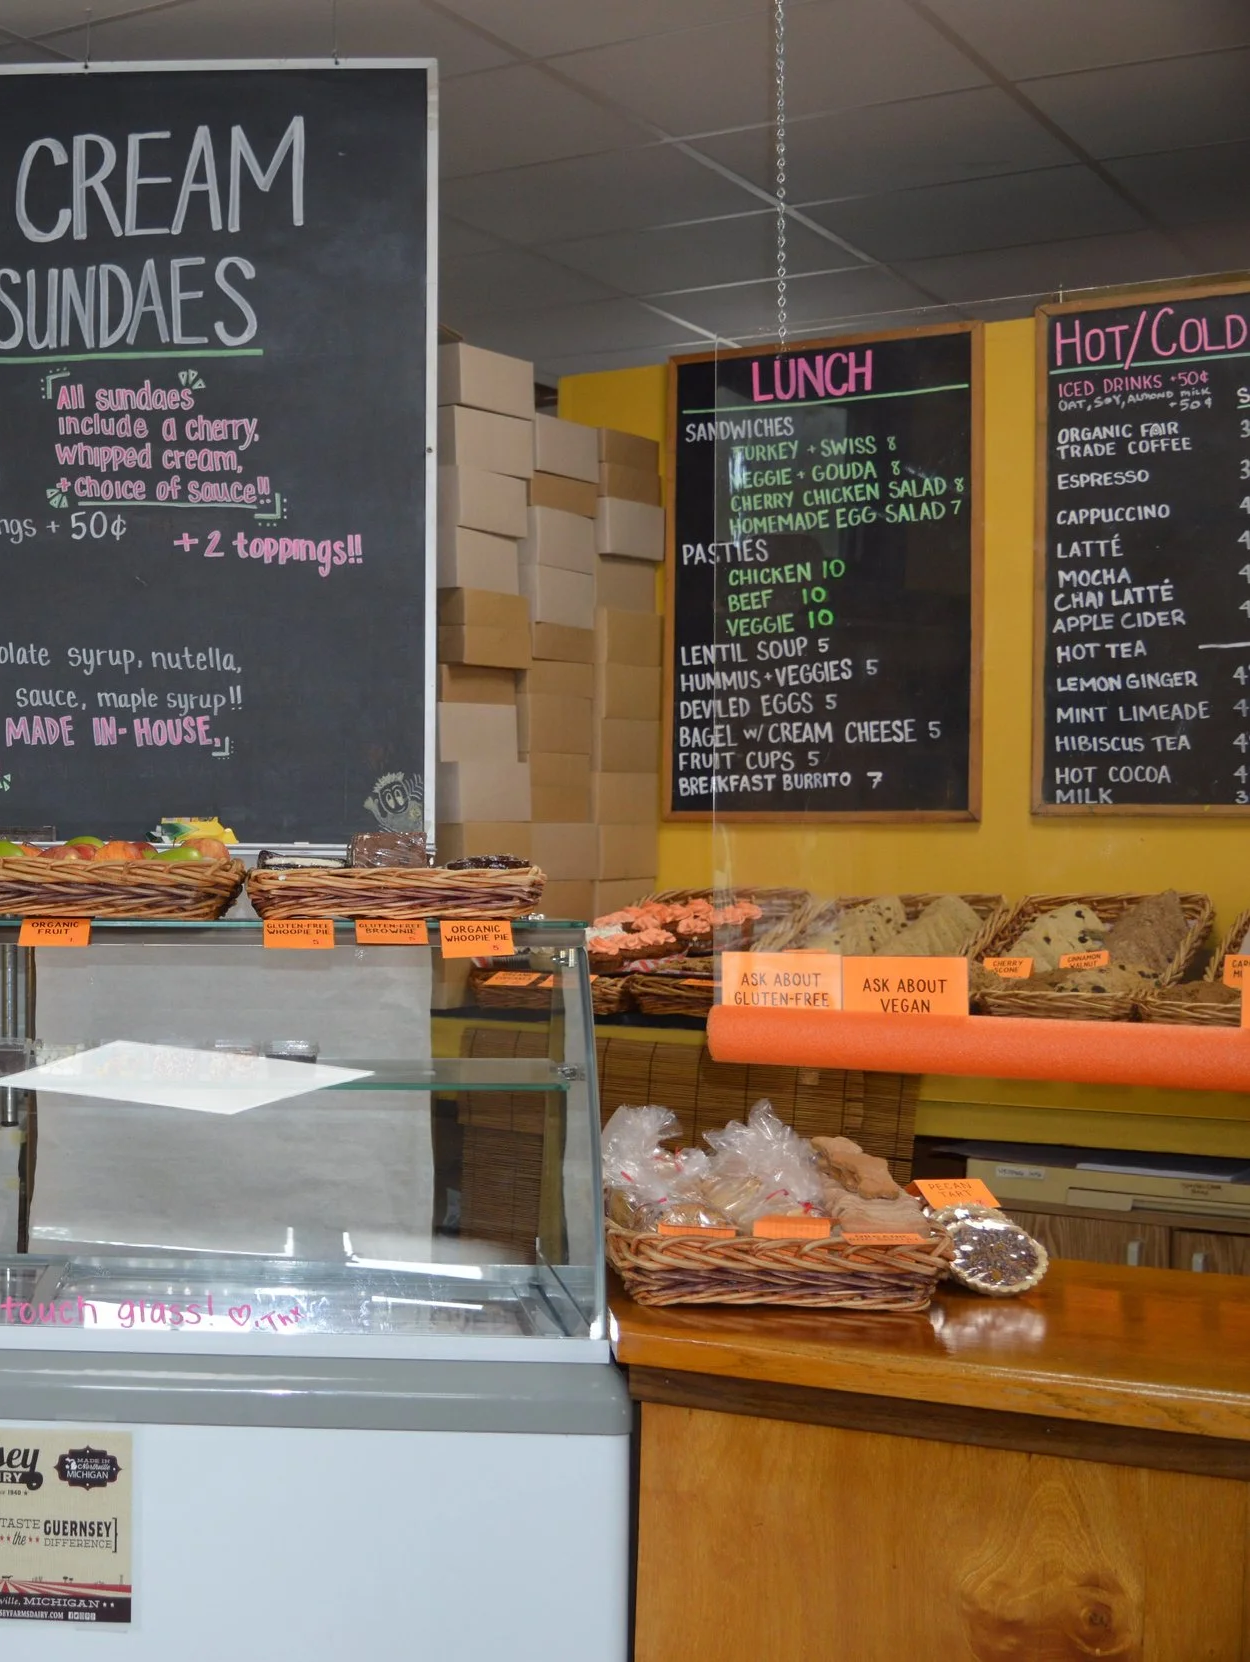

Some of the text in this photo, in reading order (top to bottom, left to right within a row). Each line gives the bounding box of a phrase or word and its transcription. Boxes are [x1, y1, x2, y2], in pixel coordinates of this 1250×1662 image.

[15, 115, 305, 243] CREAM
[1055, 307, 1249, 370] HOT/COLD
[752, 350, 873, 402] LUNCH
[1058, 380, 1095, 398] ICED
[1103, 374, 1163, 394] DRINKS
[56, 380, 195, 412] All sundaes
[58, 413, 260, 450] include cherry,
[685, 416, 794, 443] SANDWICHES
[1057, 421, 1179, 445] ORGANIC FAIR
[55, 442, 243, 473] whipped cream,
[731, 436, 877, 462] TURKEY SWISS
[1056, 437, 1193, 460] TRADE COFFEE
[811, 460, 878, 482] GOUDA
[1057, 469, 1150, 490] ESPRESSO
[156, 475, 180, 501] of
[730, 477, 947, 513] CHERRY CHICKEN SALAD
[729, 501, 946, 536] HOMEMADE EGG SALAD
[1056, 503, 1171, 526] CAPPUCCINO
[682, 538, 769, 566] PASTIES
[728, 562, 812, 587] CHICKEN
[1057, 567, 1132, 588] MOCHA
[728, 589, 773, 613] BEEF
[1054, 591, 1103, 612] CHAI
[726, 612, 795, 638] VEGGIE
[1052, 609, 1186, 633] APPLE CIDER
[68, 645, 143, 676] syrup,
[151, 647, 243, 674] nutella,
[1056, 640, 1147, 664] HOT TEA
[1056, 671, 1198, 692] LEMON GINGER
[15, 686, 87, 711] sauce,
[97, 687, 158, 713] maple
[761, 692, 813, 717] EGGS
[5, 715, 74, 747] MADE
[679, 724, 738, 748] BAGEL
[768, 722, 833, 744] CREAM
[844, 719, 917, 744] CHEESE
[678, 771, 852, 797] BREAKFAST BURRITO
[1055, 765, 1172, 785] HOT COCOA
[1055, 788, 1114, 805] MILK
[444, 933, 510, 942] WHOOPIE PIE
[451, 925, 500, 933] ORGANIC
[741, 972, 821, 987] ASK ABOUT
[863, 978, 947, 994] ASK ABOUT
[734, 991, 830, 1007] GLUTEN-FREE
[880, 998, 931, 1013] VEGAN
[928, 1182, 971, 1190] PECAN
[938, 1190, 971, 1198] TART
[0, 1295, 98, 1326] touch
[66, 1470, 109, 1479] MICHIGAN
[0, 1517, 112, 1538] TASTE GUERNSEY
[12, 1531, 112, 1549] the DIFFERENCE
[23, 1596, 100, 1609] MICHIGAN
